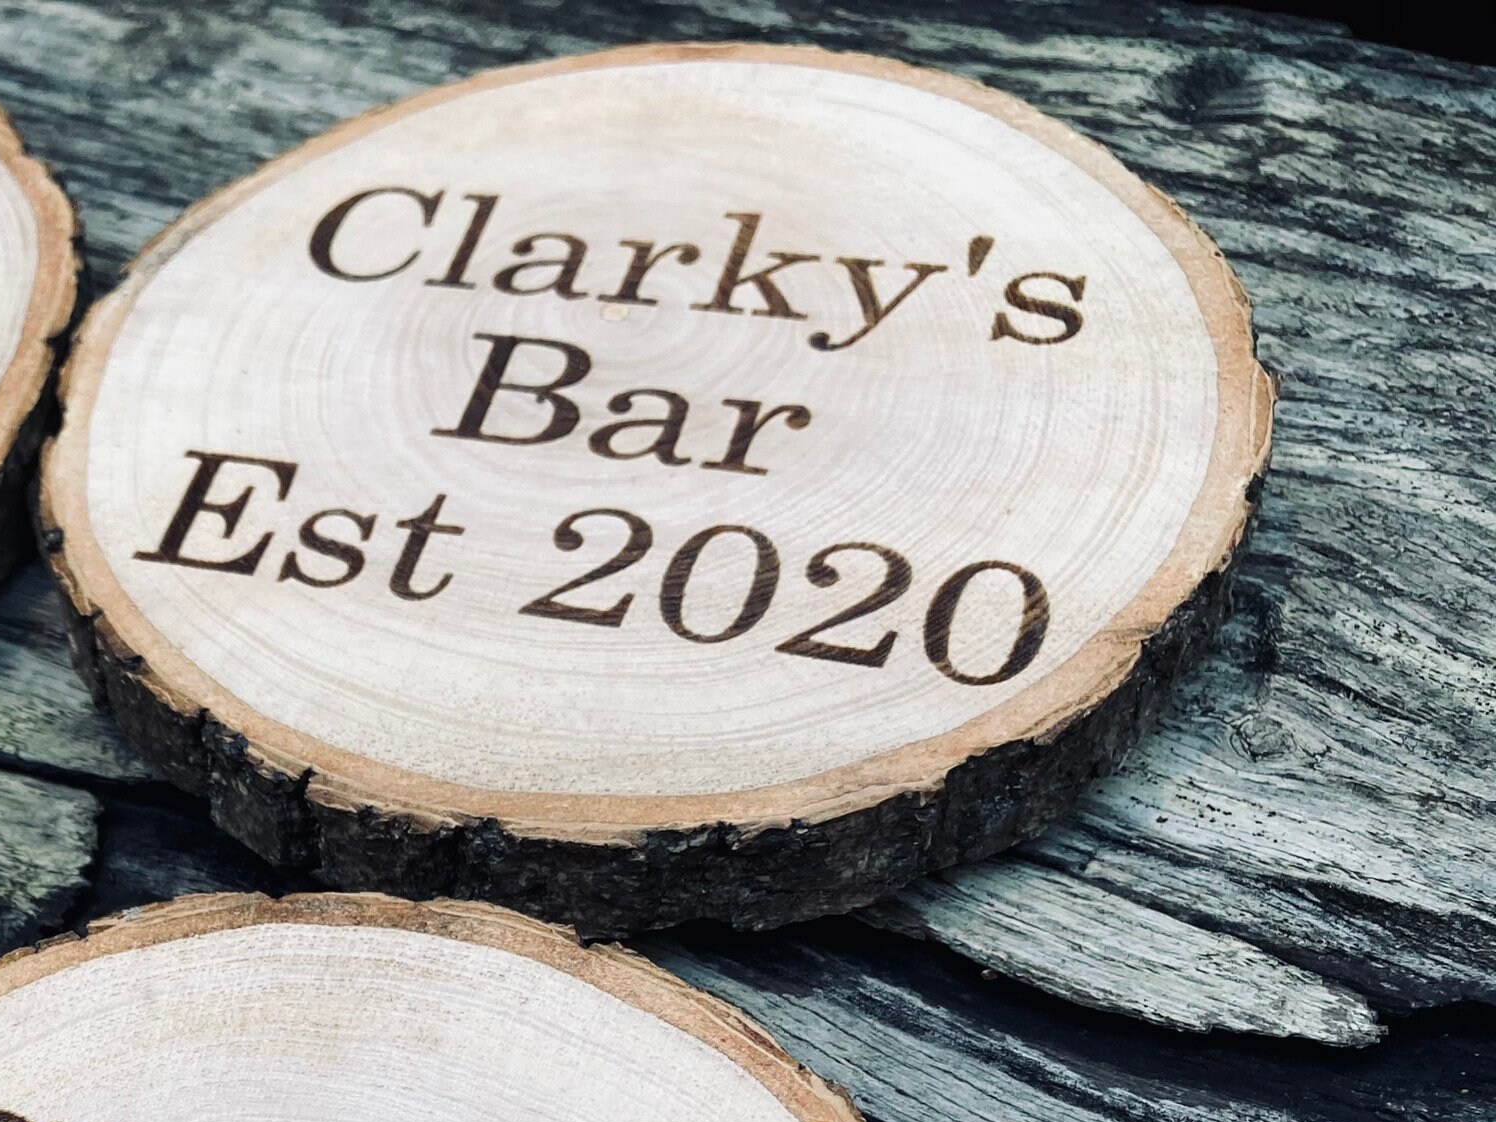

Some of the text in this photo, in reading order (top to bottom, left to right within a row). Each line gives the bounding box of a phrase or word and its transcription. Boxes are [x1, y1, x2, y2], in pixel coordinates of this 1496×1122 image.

[308, 186, 1086, 353] Clarky's
[430, 332, 813, 477] Bar
[133, 449, 1051, 688] Est 2020
